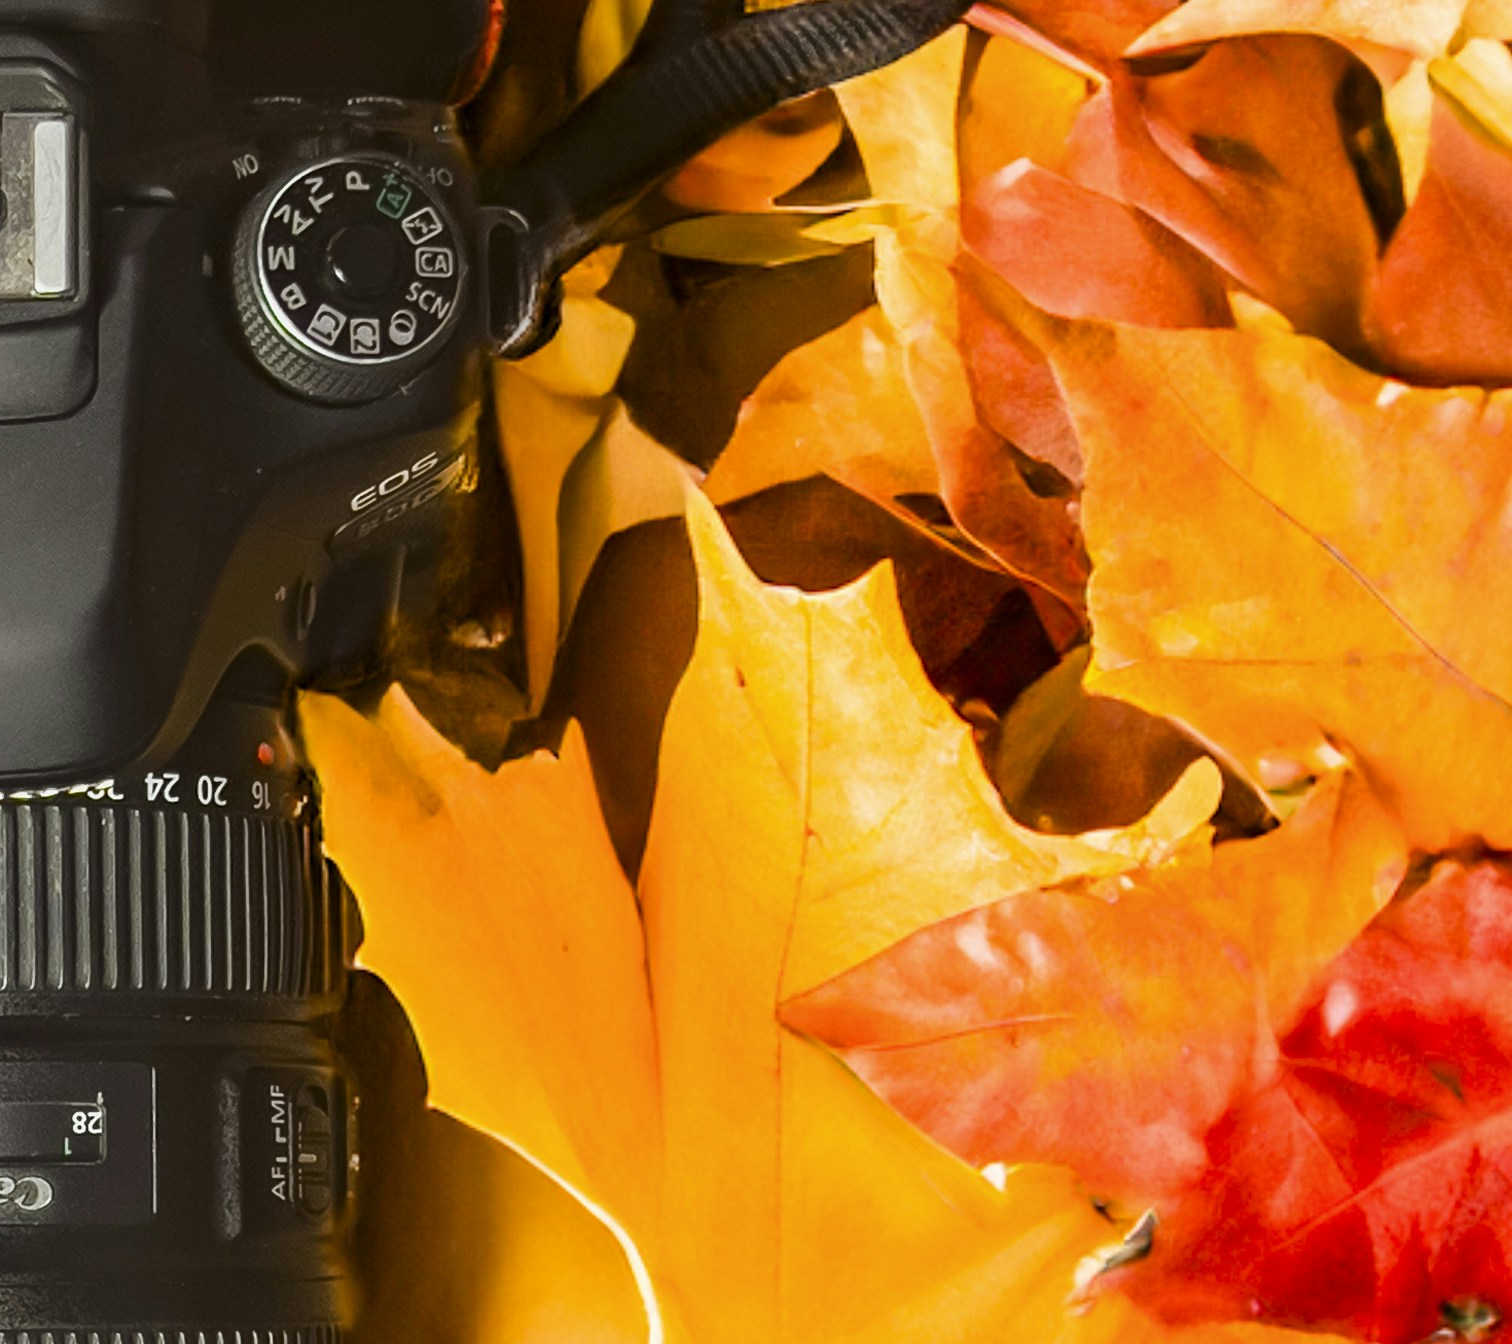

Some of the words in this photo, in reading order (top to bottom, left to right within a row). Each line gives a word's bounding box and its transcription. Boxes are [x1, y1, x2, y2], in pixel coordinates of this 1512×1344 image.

[232, 153, 259, 180] ON
[345, 170, 370, 191] P
[304, 175, 335, 214] Tv
[273, 203, 315, 237] Av
[267, 245, 296, 271] M
[420, 254, 448, 272] CA
[279, 281, 308, 311] B
[404, 281, 451, 320] SCN
[350, 451, 439, 512] EOS
[145, 772, 180, 803] 24
[197, 775, 228, 807] 20
[251, 781, 271, 810] 16
[270, 1084, 286, 1125] MF
[71, 1110, 104, 1135] 28
[271, 1166, 286, 1201] AF
